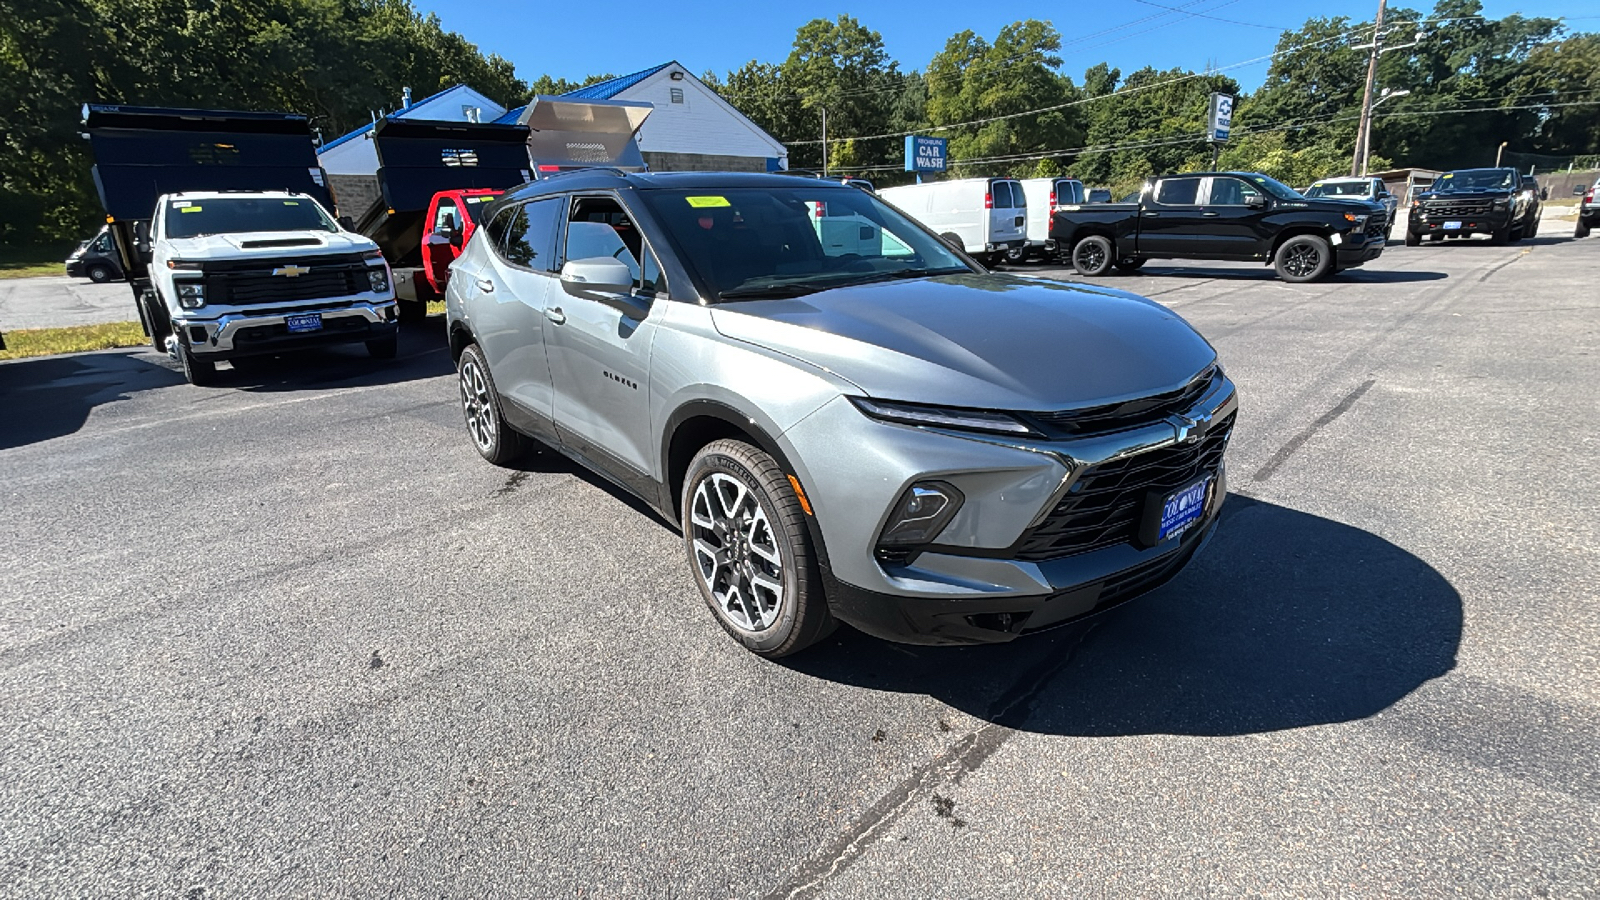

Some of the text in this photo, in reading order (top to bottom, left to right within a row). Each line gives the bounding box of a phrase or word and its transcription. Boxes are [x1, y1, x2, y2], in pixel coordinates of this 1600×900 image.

[919, 146, 940, 157] CAR
[916, 157, 944, 168] WASH
[603, 370, 637, 390] BLAZER
[720, 458, 759, 489] MICHELIN
